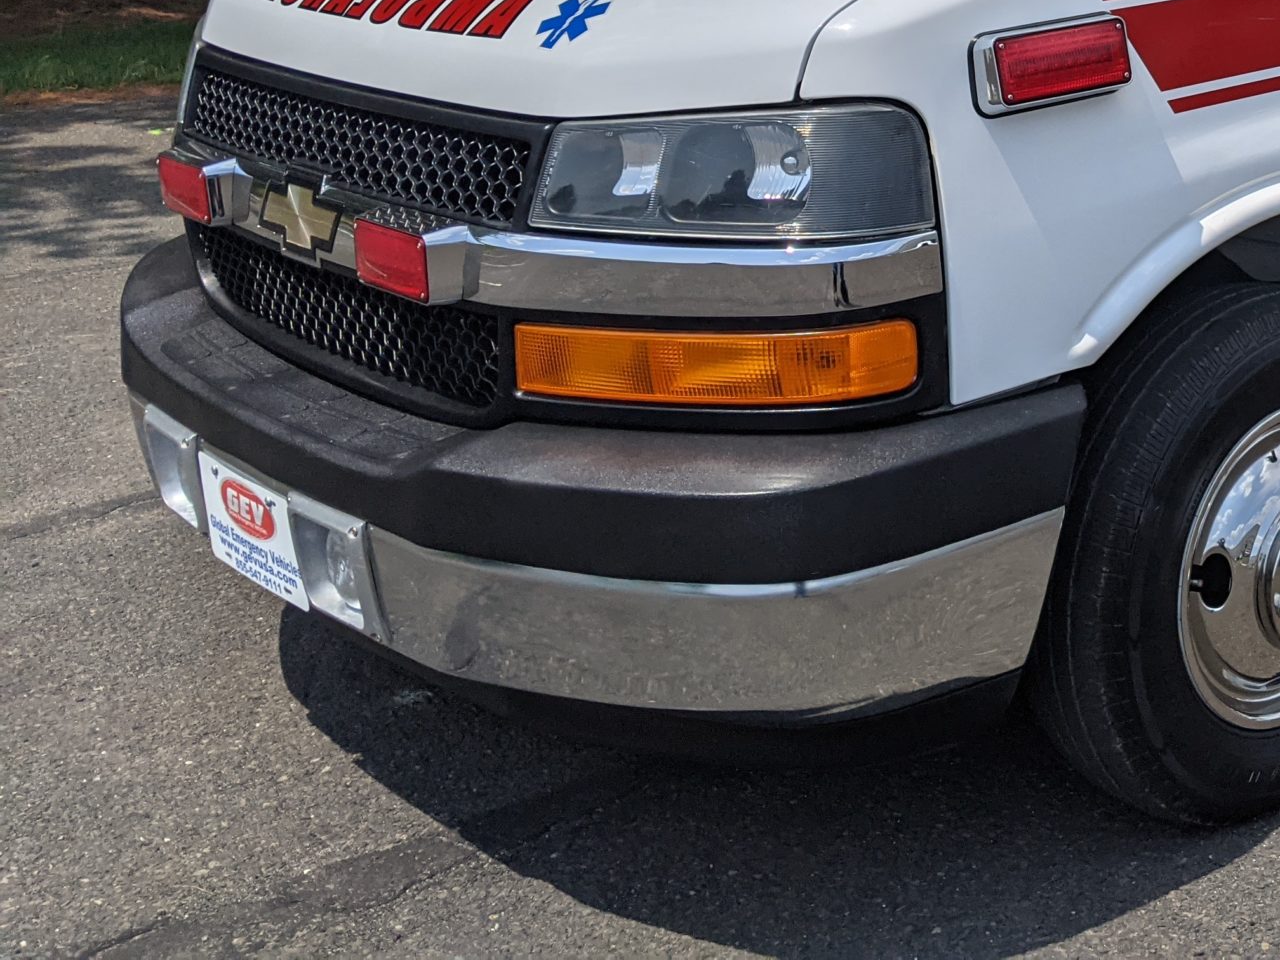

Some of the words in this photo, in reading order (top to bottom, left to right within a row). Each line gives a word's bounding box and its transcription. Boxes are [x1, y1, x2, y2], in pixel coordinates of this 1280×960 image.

[226, 487, 265, 527] GEV
[210, 514, 230, 537] Global
[231, 527, 268, 564] Emergency
[269, 549, 302, 579] Vehicles
[219, 534, 298, 590] www.gevusa.com
